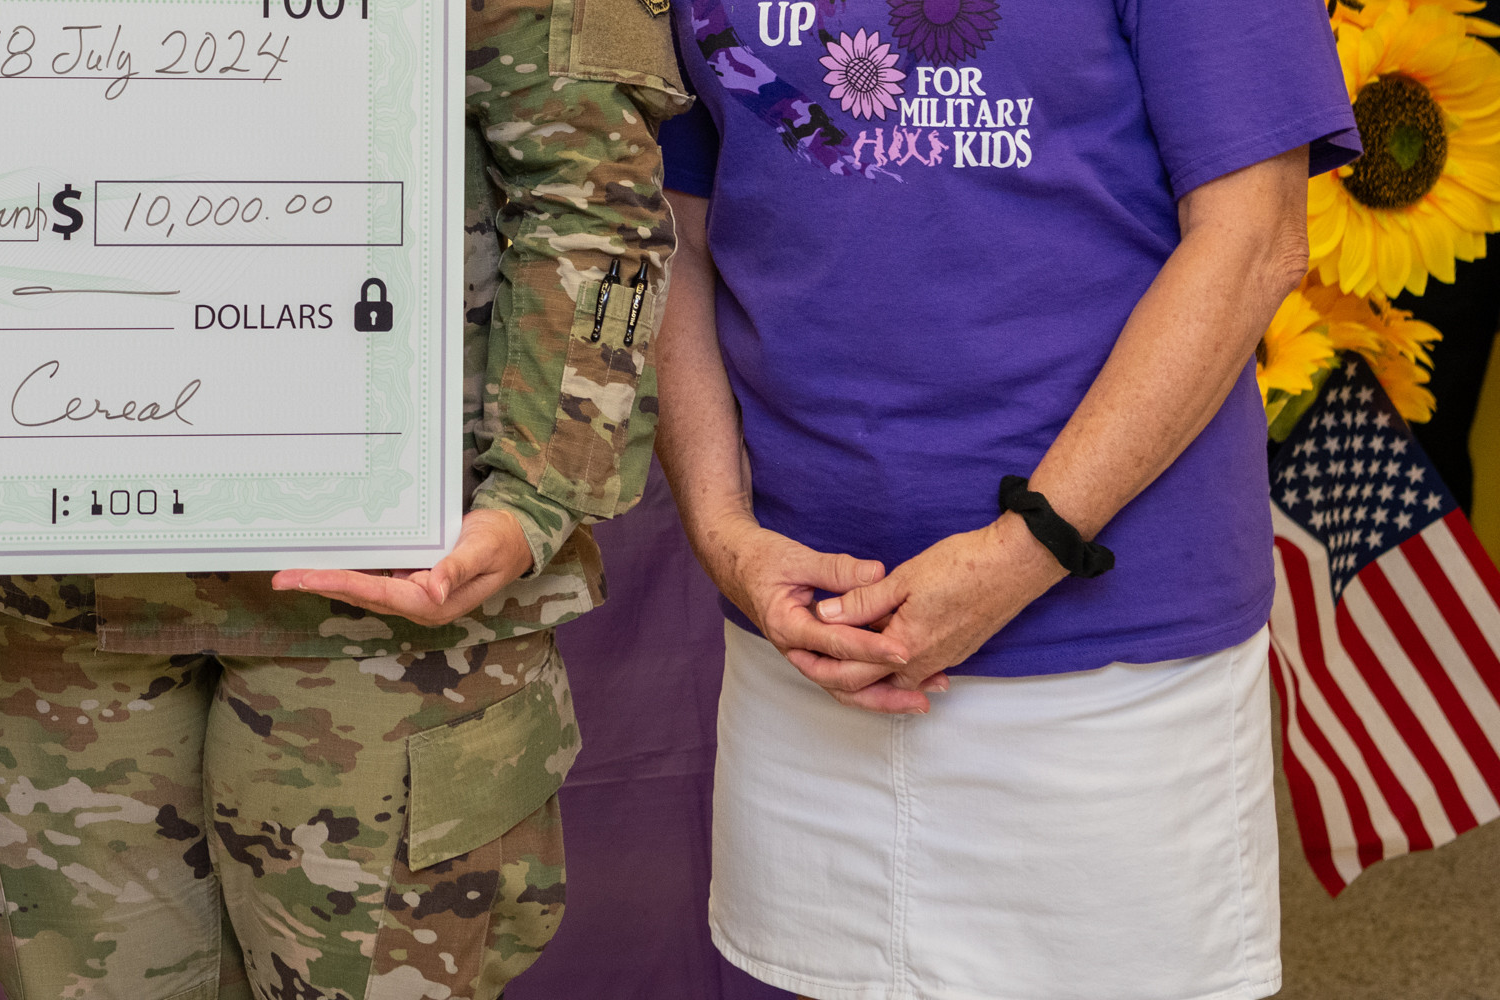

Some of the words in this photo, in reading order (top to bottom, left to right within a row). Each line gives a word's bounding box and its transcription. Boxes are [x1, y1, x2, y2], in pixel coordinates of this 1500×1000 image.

[758, 1, 816, 46] UP
[52, 24, 140, 101] July
[155, 30, 289, 83] 2024
[916, 66, 987, 96] FOR
[899, 98, 1034, 128] MILITARY
[953, 128, 1032, 168] KIDS
[51, 183, 84, 241] $
[123, 192, 333, 237] 10,000.00
[194, 303, 334, 330] DOLLARS
[629, 309, 637, 326] PILOT
[11, 360, 202, 427] Cereal
